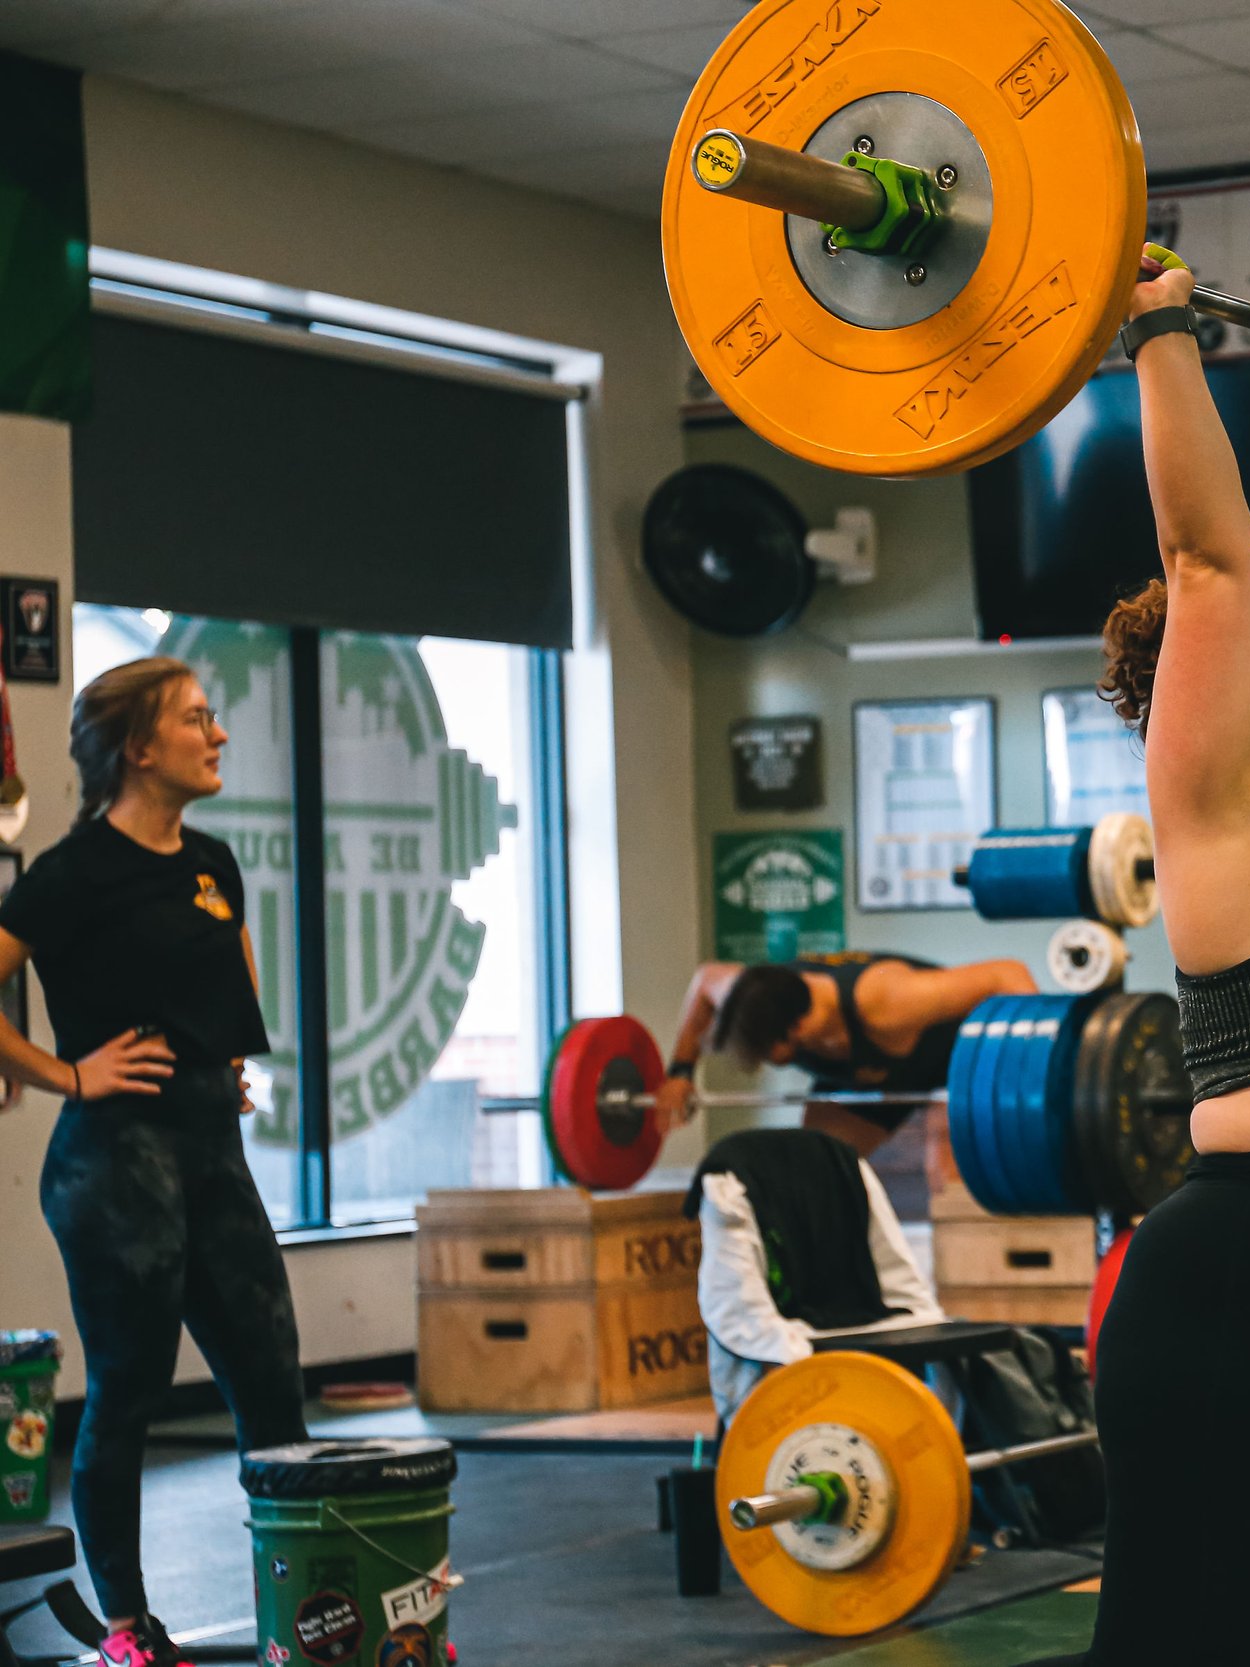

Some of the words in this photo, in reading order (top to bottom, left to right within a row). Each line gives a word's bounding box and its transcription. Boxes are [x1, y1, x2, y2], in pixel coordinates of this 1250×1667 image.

[1010, 45, 1063, 108] 15
[700, 150, 735, 173] ROGUE
[724, 311, 767, 366] 15
[625, 1232, 701, 1277] ROG
[629, 1325, 706, 1376] ROG
